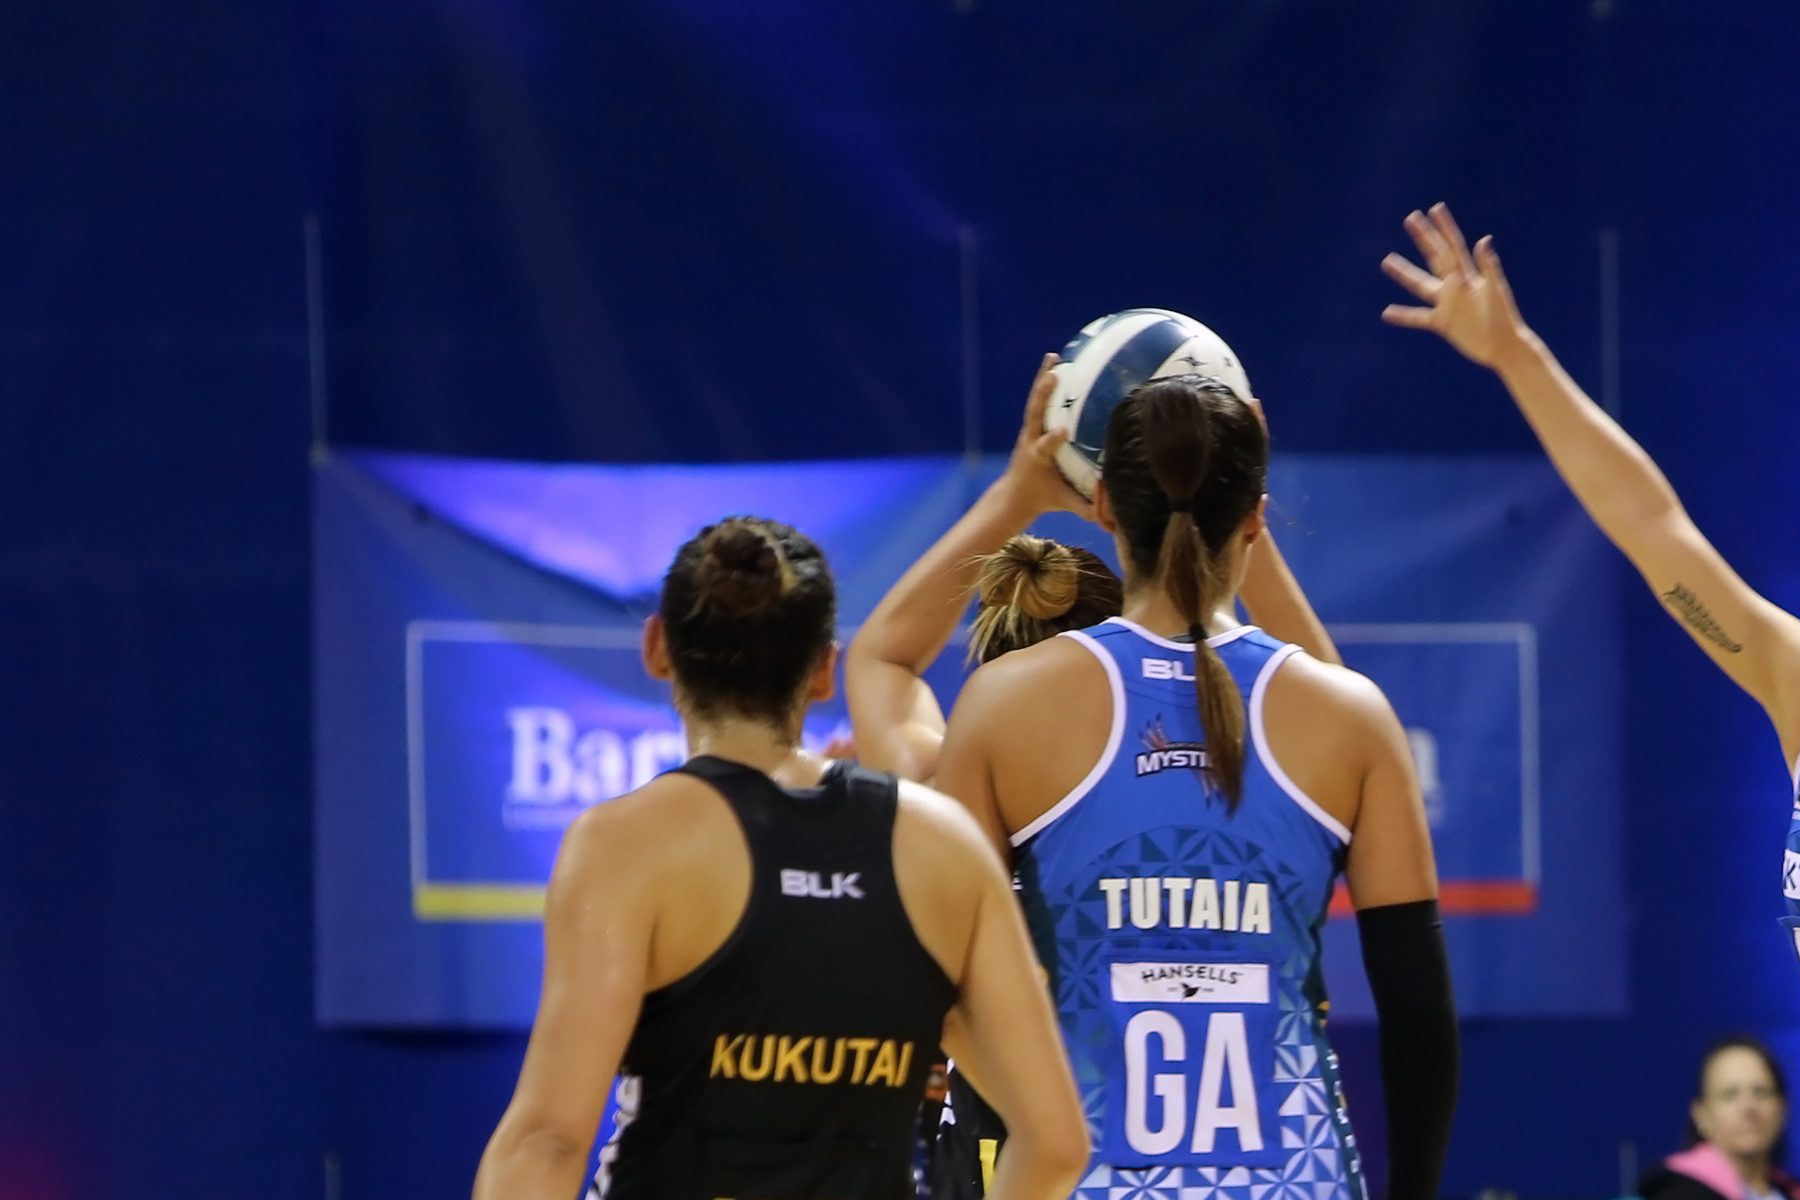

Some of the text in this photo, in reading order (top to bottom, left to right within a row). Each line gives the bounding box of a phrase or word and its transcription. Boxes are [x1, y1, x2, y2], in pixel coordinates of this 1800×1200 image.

[1141, 657, 1197, 682] BL
[1136, 749, 1212, 776] MYSTI
[780, 867, 863, 899] BLK
[1100, 876, 1271, 935] TUTAIA
[1141, 964, 1245, 985] HANSELLS
[709, 1033, 914, 1088] KUKUTAI
[1122, 1009, 1264, 1156] GA
